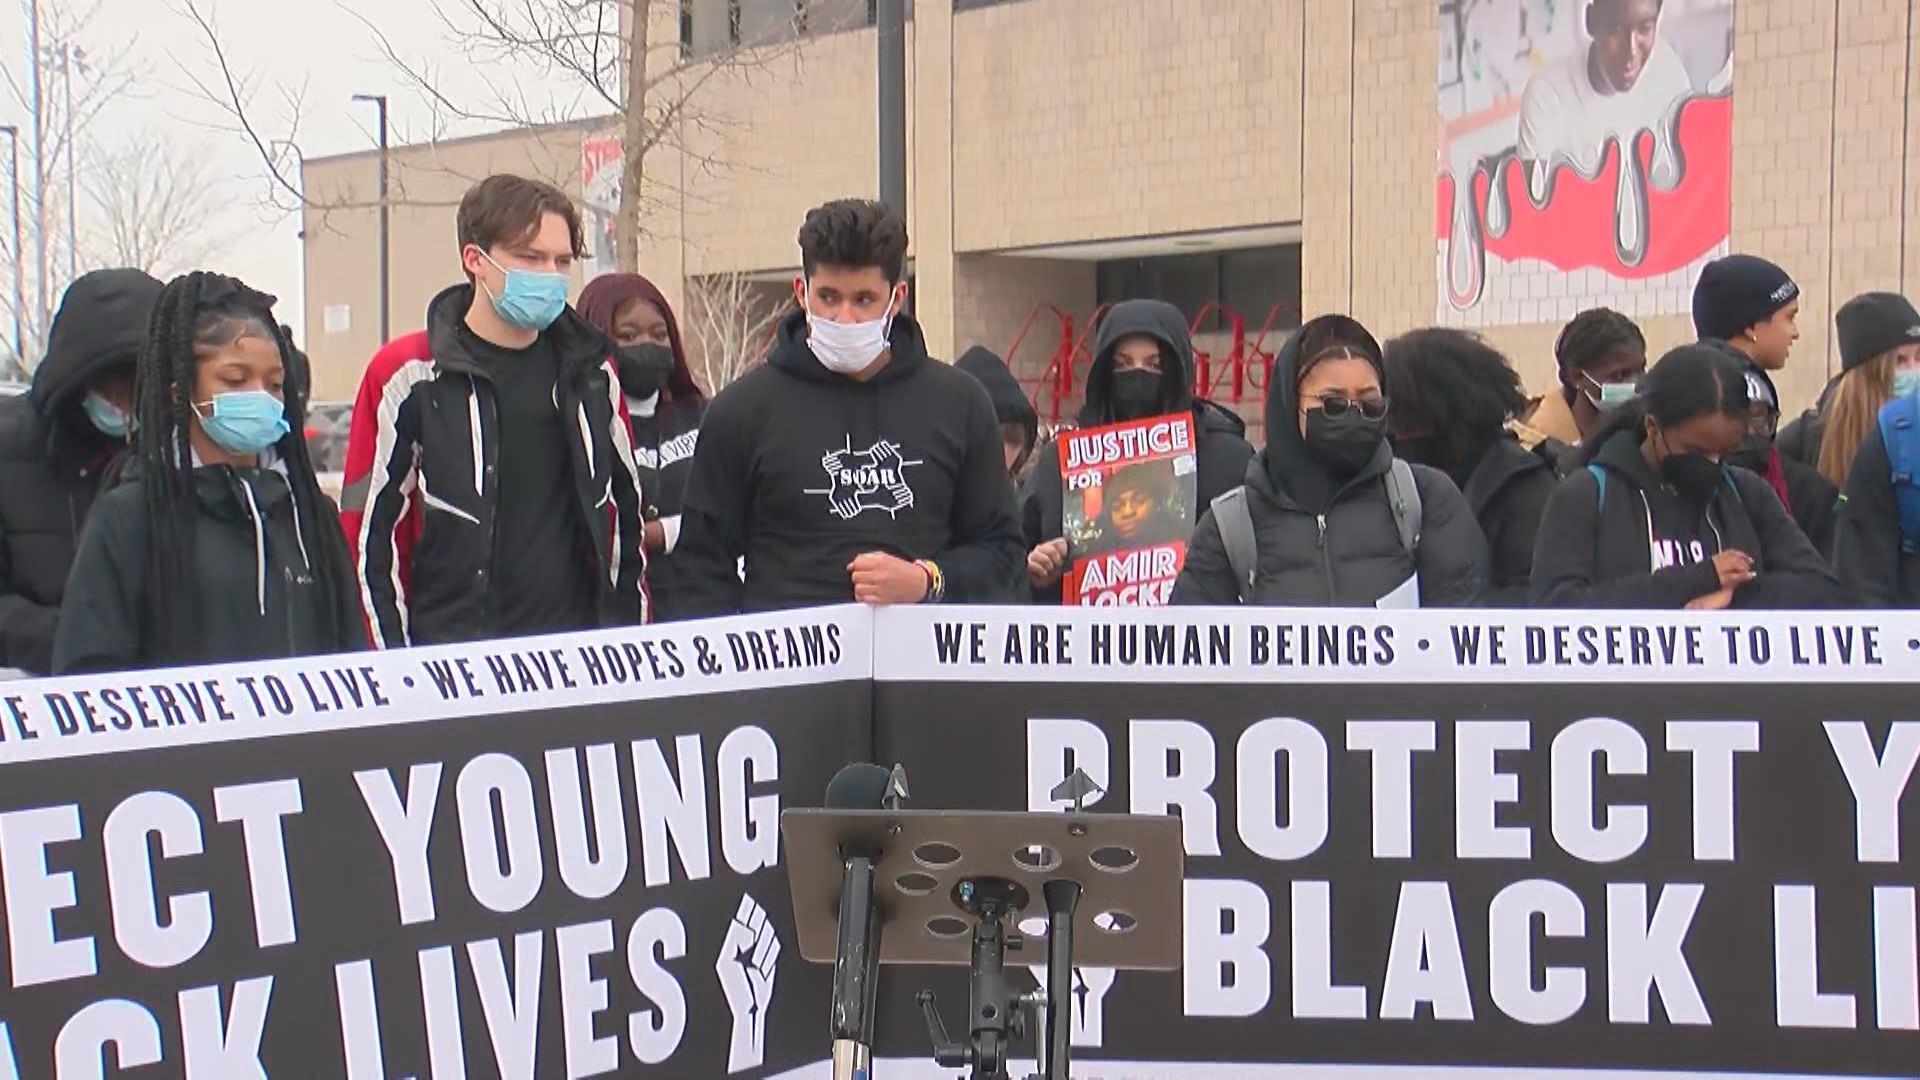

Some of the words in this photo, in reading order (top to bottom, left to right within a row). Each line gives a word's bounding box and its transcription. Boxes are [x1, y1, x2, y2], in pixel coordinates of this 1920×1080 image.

[840, 469, 896, 486] SOAR
[1067, 420, 1188, 468] JUSTICE
[1068, 470, 1103, 490] FOR
[1080, 547, 1177, 594] AMIR
[0, 695, 38, 742] E
[43, 679, 235, 737] DESERVE
[237, 674, 294, 717] TO
[298, 666, 390, 712] LIVE
[421, 657, 484, 700] WE
[485, 648, 577, 694] HAVE
[578, 638, 685, 686] HOPES
[692, 635, 722, 675] &
[726, 623, 842, 672] DREAMS
[934, 623, 987, 665] WE
[1003, 623, 1073, 665] ARE
[1091, 624, 1231, 666] HUMAN
[1250, 624, 1396, 666] BEINGS
[1449, 625, 1507, 666] WE
[1526, 625, 1704, 666] DESERVE
[1721, 625, 1772, 666] TO
[1790, 625, 1883, 666] LIVE
[353, 725, 780, 926] YOUNG
[1027, 717, 1760, 863] PROTECT
[335, 907, 686, 1080] LIVES
[1183, 878, 1712, 1025] BLACK
[1773, 884, 1920, 1030] LI
